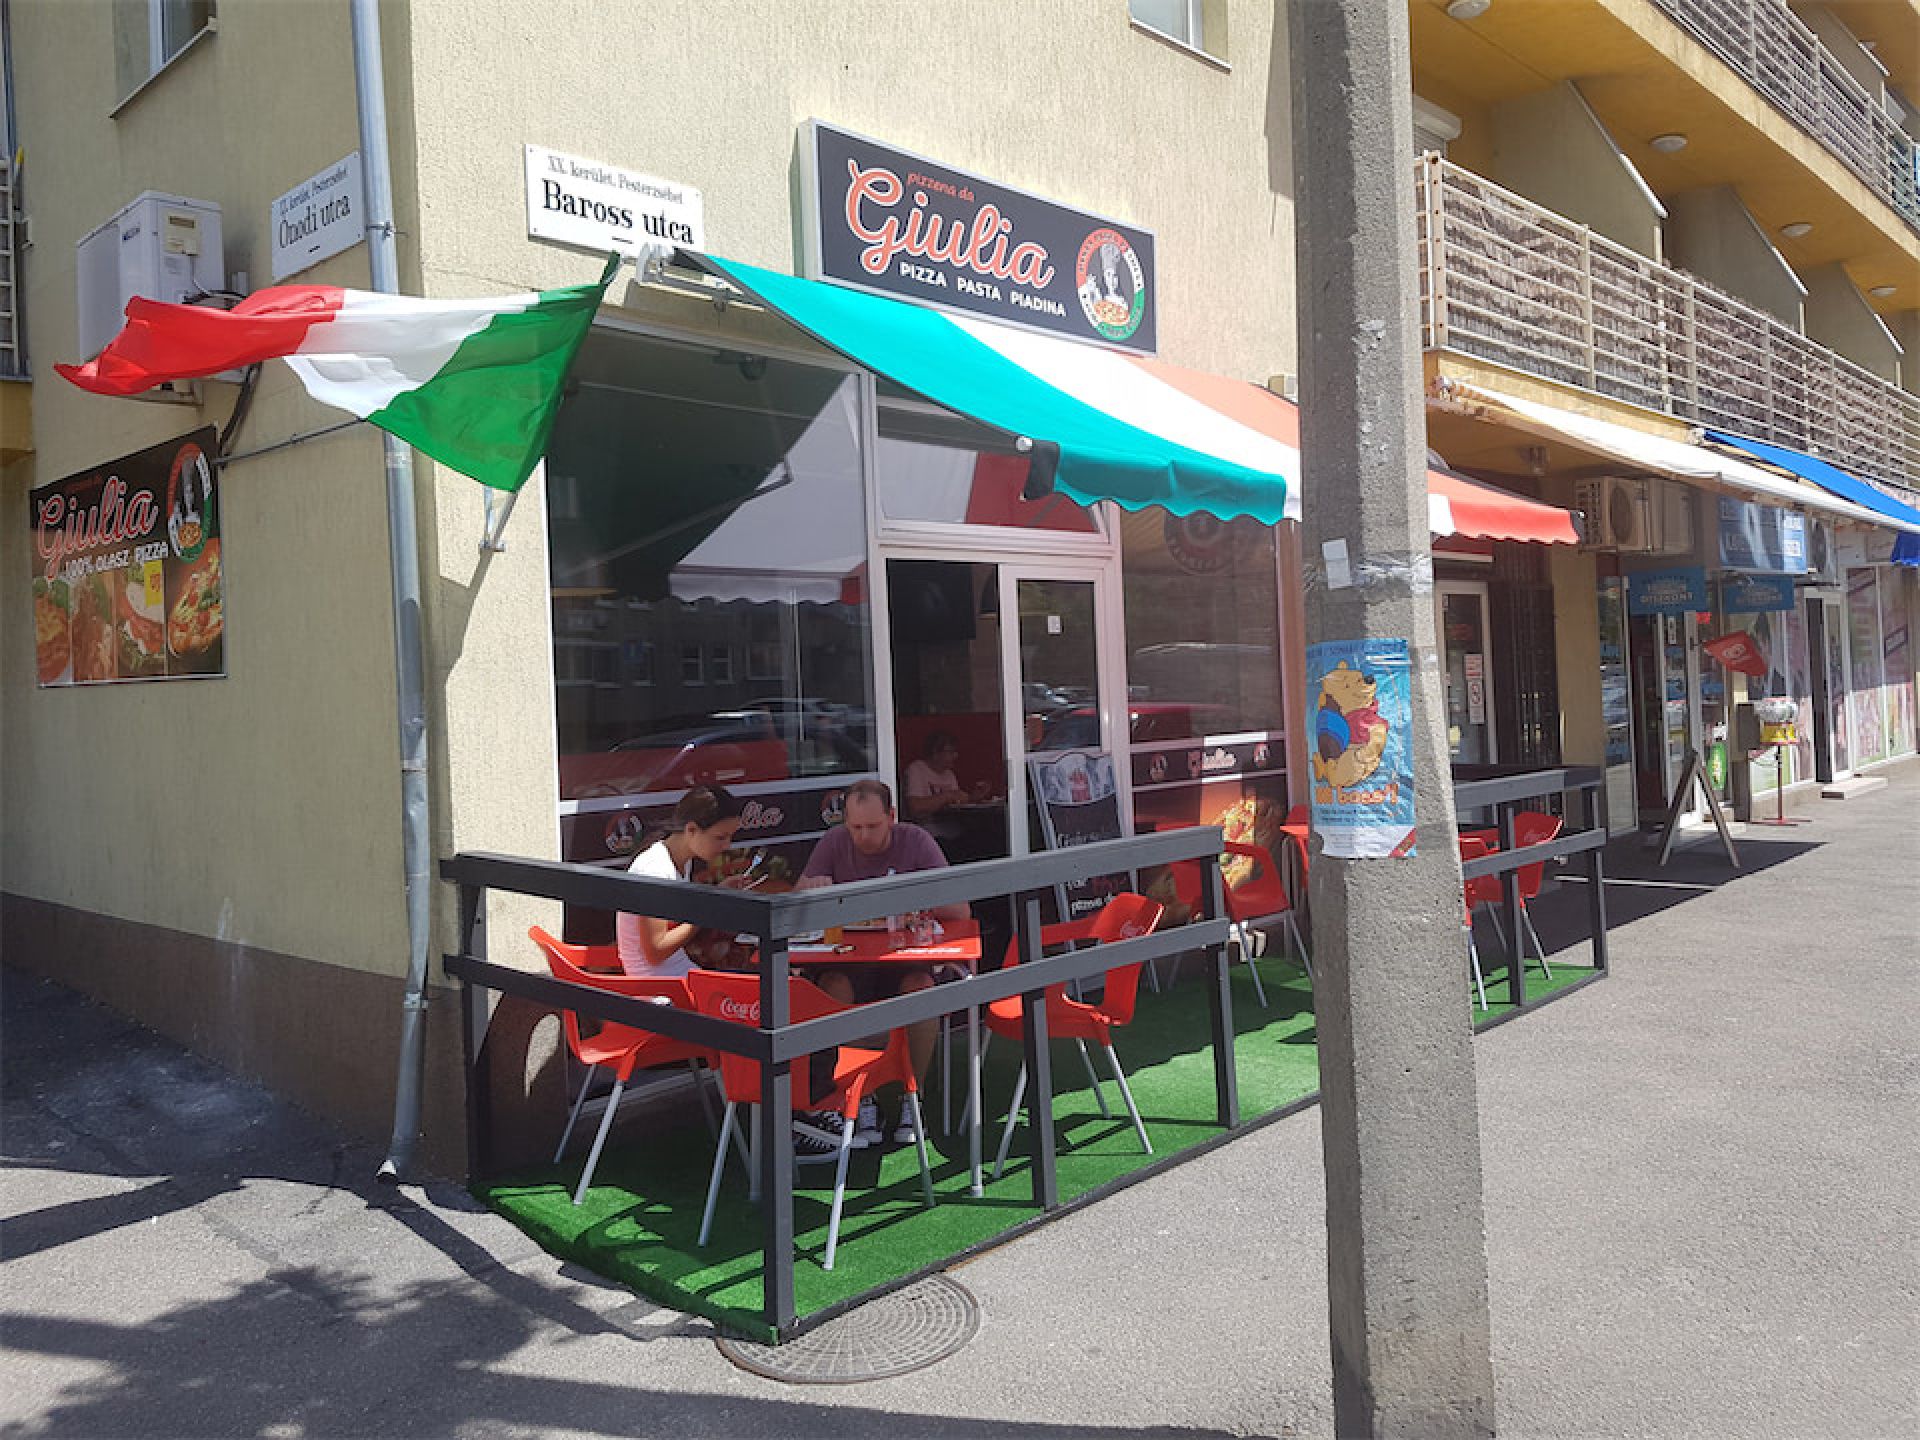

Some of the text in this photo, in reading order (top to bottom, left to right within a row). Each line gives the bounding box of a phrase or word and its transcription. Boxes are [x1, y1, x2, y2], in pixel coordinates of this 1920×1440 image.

[319, 192, 351, 227] utca
[541, 177, 695, 245] Baross utca
[845, 158, 1056, 289] Giulia
[959, 186, 976, 204] da
[899, 260, 1068, 318] PIZZA PASTA PIADINA
[37, 475, 160, 587] Giulia
[95, 549, 130, 573] OLASZ
[134, 540, 170, 565] PIZZA
